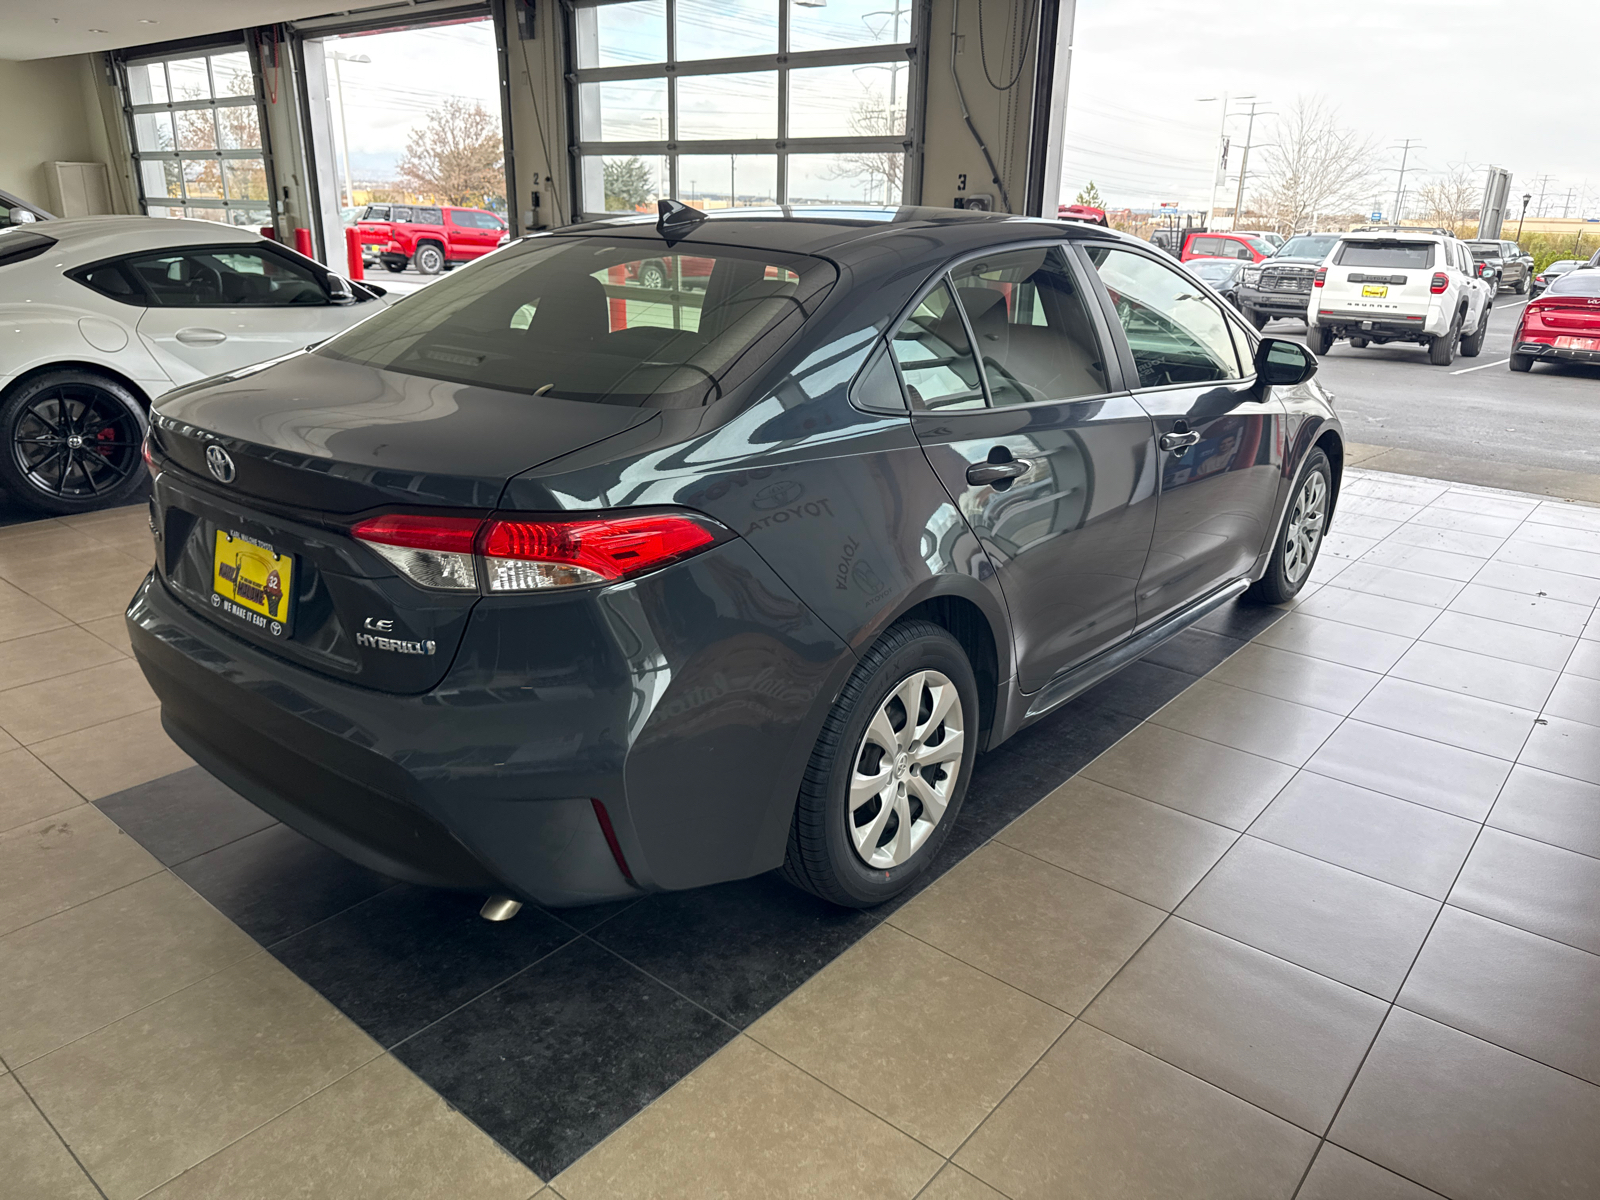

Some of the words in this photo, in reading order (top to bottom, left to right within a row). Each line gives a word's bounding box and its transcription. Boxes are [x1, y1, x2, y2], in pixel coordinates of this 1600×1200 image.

[533, 172, 540, 185] 2
[957, 174, 967, 191] 3
[268, 575, 279, 590] 32
[223, 600, 231, 612] WE
[232, 603, 247, 619] MAKE
[246, 610, 252, 622] IT
[253, 614, 267, 628] EASY
[363, 616, 394, 632] LE
[356, 632, 423, 655] HYBRID
